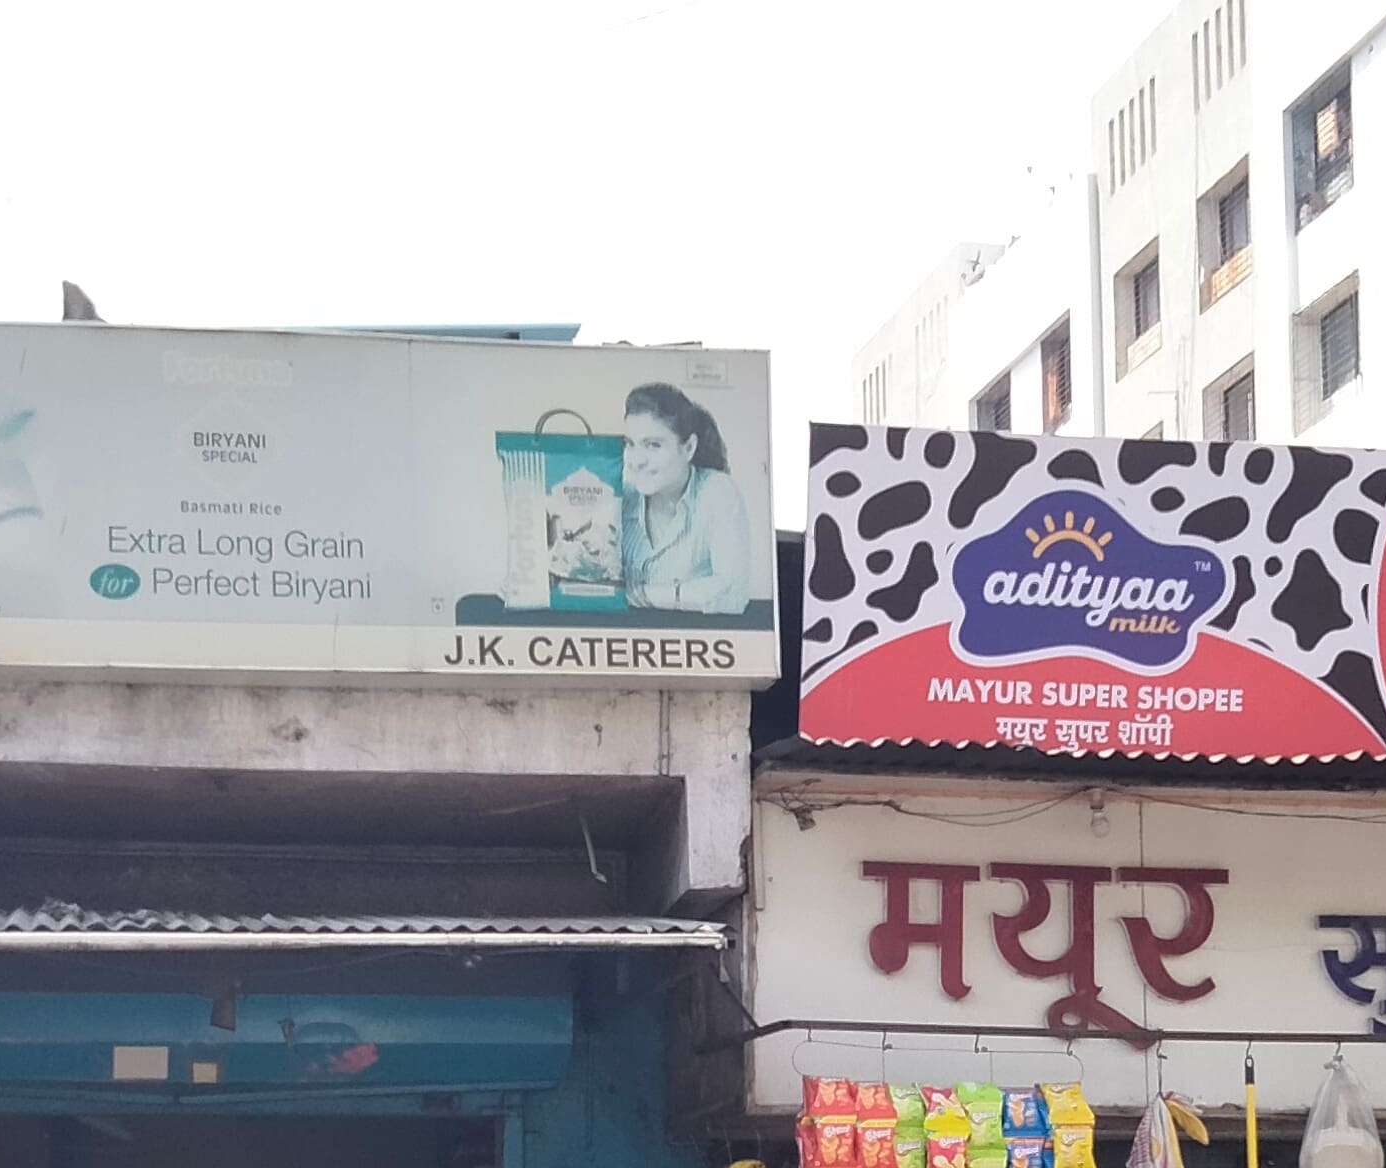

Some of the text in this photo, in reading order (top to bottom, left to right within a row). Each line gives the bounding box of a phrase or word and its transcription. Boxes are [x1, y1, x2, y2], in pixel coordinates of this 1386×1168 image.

[193, 431, 267, 449] BIRYANI
[201, 449, 258, 464] SPECIAL
[180, 500, 283, 516] Basmati Rice
[108, 525, 365, 564] Extra Long Grain
[97, 565, 371, 605] for Perfect Biryani
[983, 560, 1195, 629] adityaa
[1108, 614, 1181, 636] milk
[444, 635, 737, 670] J.K. CATERERS
[927, 678, 1245, 714] MAYUR SUPER SHOPEE
[996, 713, 1174, 750] मयूर सुपर शॉपी
[862, 861, 1229, 1050] मयूर
